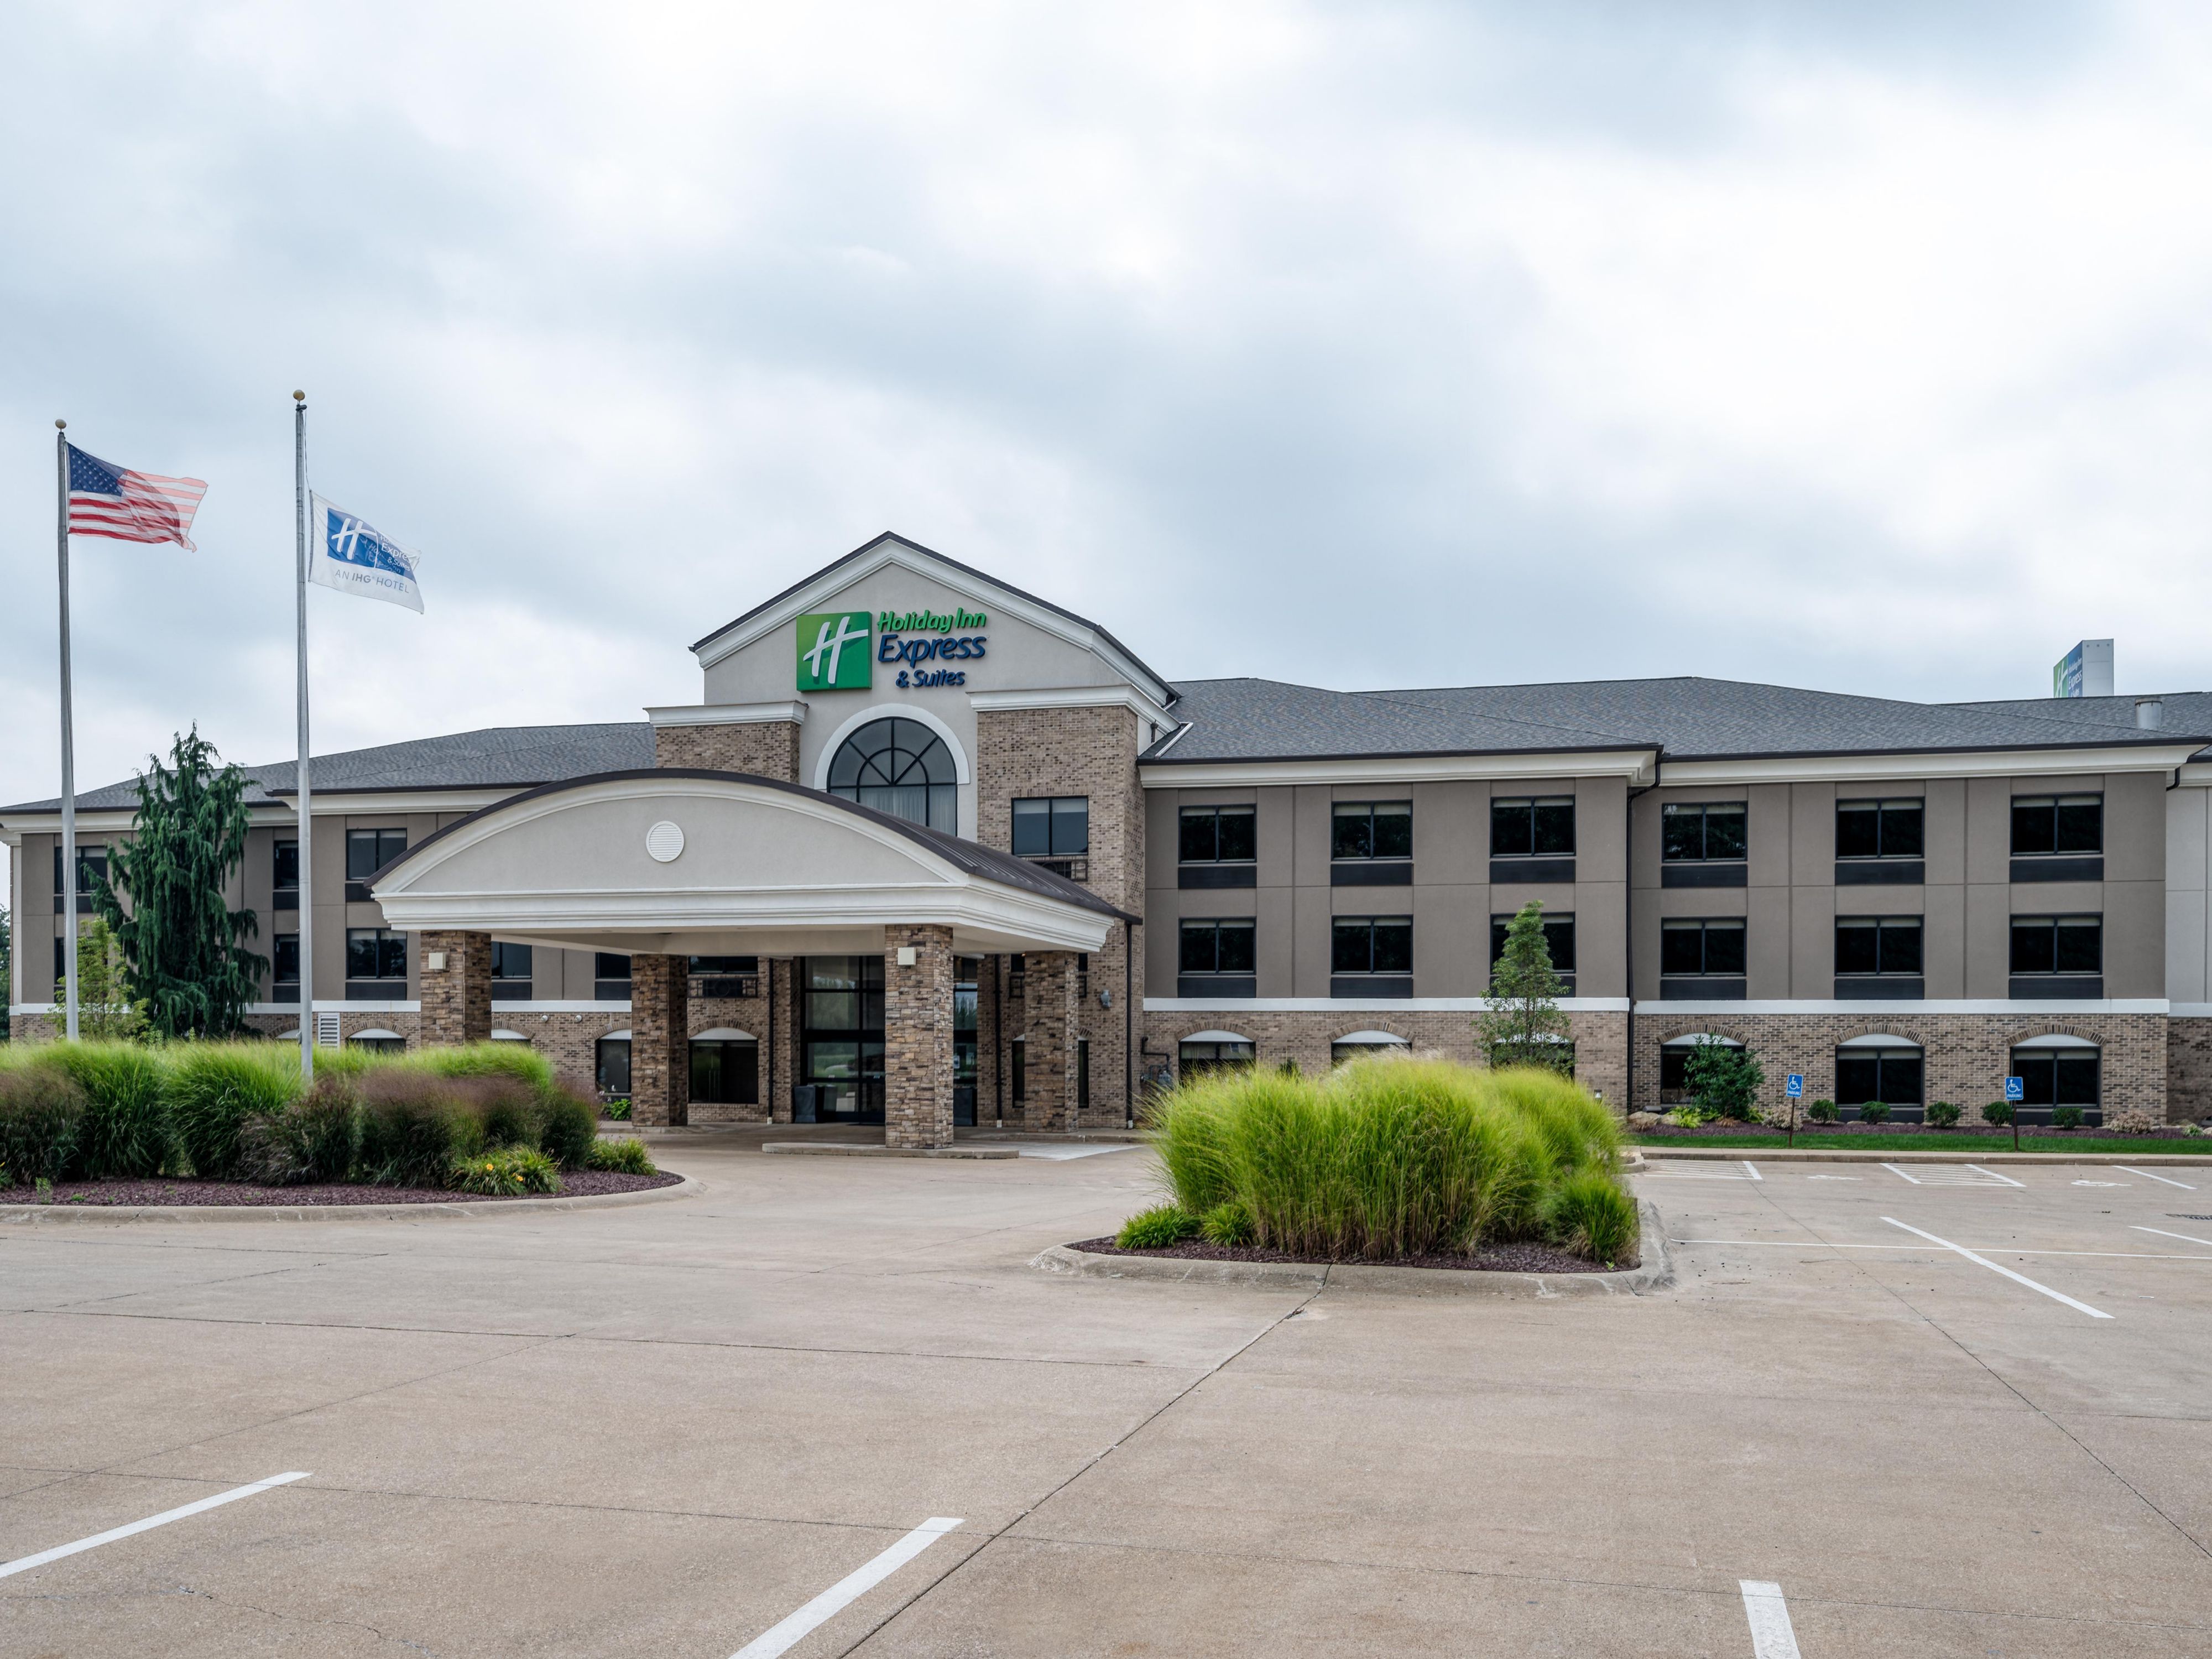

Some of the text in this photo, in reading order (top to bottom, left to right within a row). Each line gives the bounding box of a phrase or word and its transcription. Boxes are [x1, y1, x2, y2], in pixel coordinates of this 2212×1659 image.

[381, 542, 410, 562] Expre
[393, 559, 410, 571] Suites
[335, 569, 409, 593] AN IHG HOTEL
[877, 607, 987, 634] Holiday Inn
[878, 634, 987, 669] Express
[895, 669, 966, 688] & Suites
